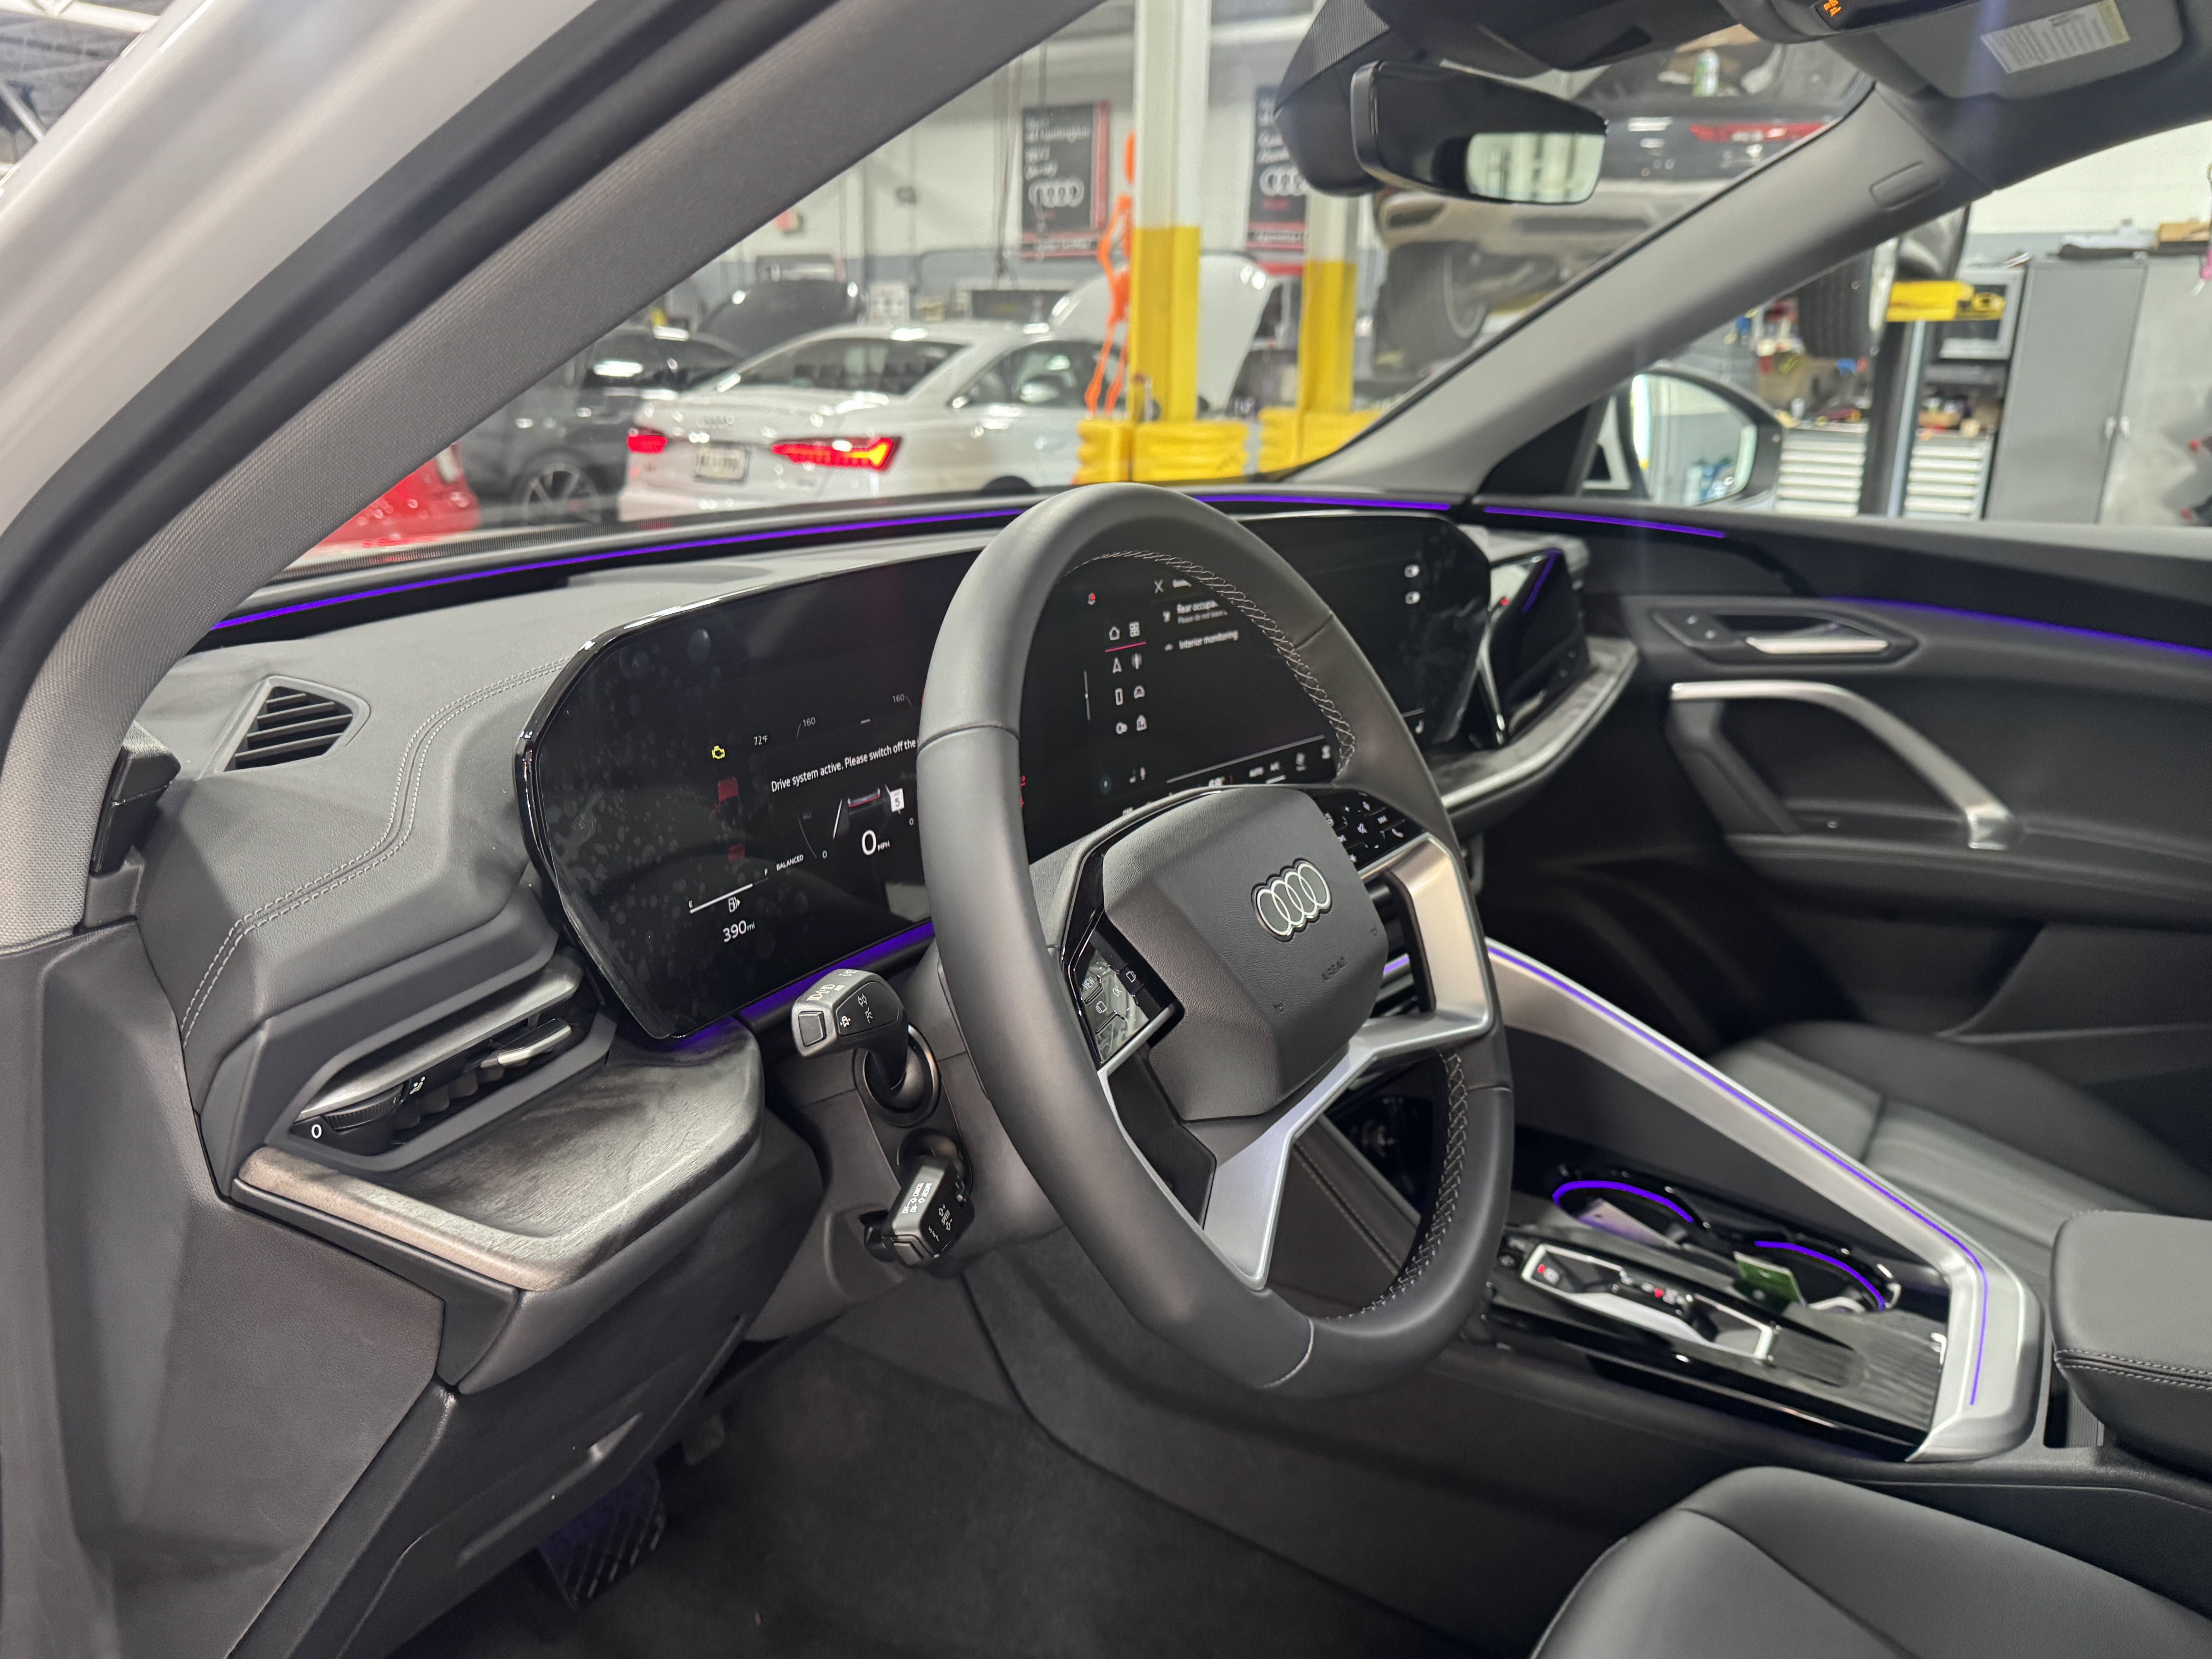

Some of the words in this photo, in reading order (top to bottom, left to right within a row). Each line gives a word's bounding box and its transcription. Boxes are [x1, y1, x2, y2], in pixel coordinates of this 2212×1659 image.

[1179, 638, 1203, 650] Interior
[1203, 630, 1239, 645] monitoring
[893, 693, 905, 704] 160
[802, 716, 816, 727] 160
[771, 778, 791, 792] Drive
[792, 769, 819, 787] system
[820, 761, 844, 776] active.
[844, 754, 869, 769] Please
[869, 745, 892, 761] switch
[893, 740, 904, 754] off
[903, 738, 916, 750] the
[895, 797, 900, 807] 5
[908, 817, 914, 826] 0
[862, 830, 877, 855] 0
[877, 840, 890, 852] MPH
[822, 850, 828, 859] 0
[776, 854, 804, 871] BALANCED
[1112, 985, 1122, 997] OK
[928, 1226, 939, 1242] SET
